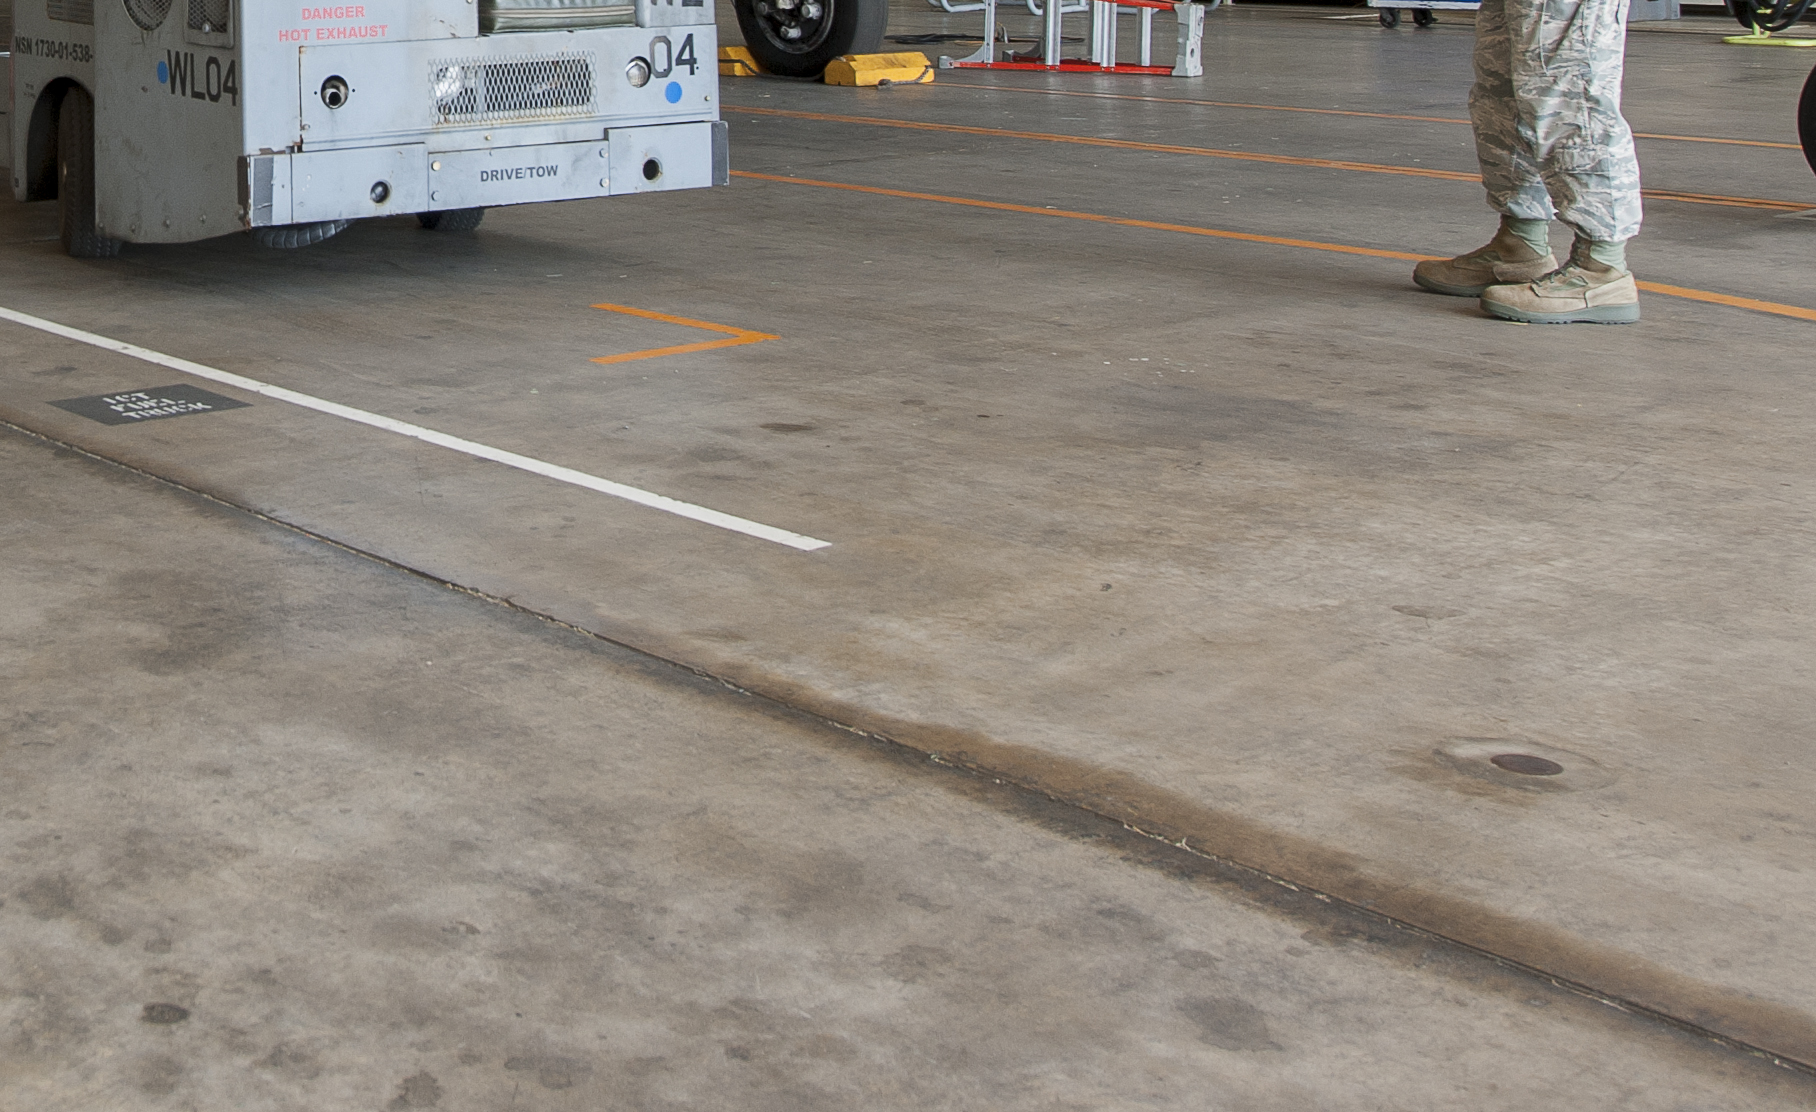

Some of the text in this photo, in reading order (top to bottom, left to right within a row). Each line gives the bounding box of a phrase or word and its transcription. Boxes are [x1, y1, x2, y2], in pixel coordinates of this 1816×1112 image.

[301, 5, 366, 20] DANGER
[278, 24, 388, 42] HOT EXHAUST
[15, 35, 32, 55] NSN
[649, 33, 697, 78] 04
[167, 49, 238, 106] WL04
[480, 165, 559, 182] DRIVE/TOW
[122, 402, 212, 419] TRUCK
